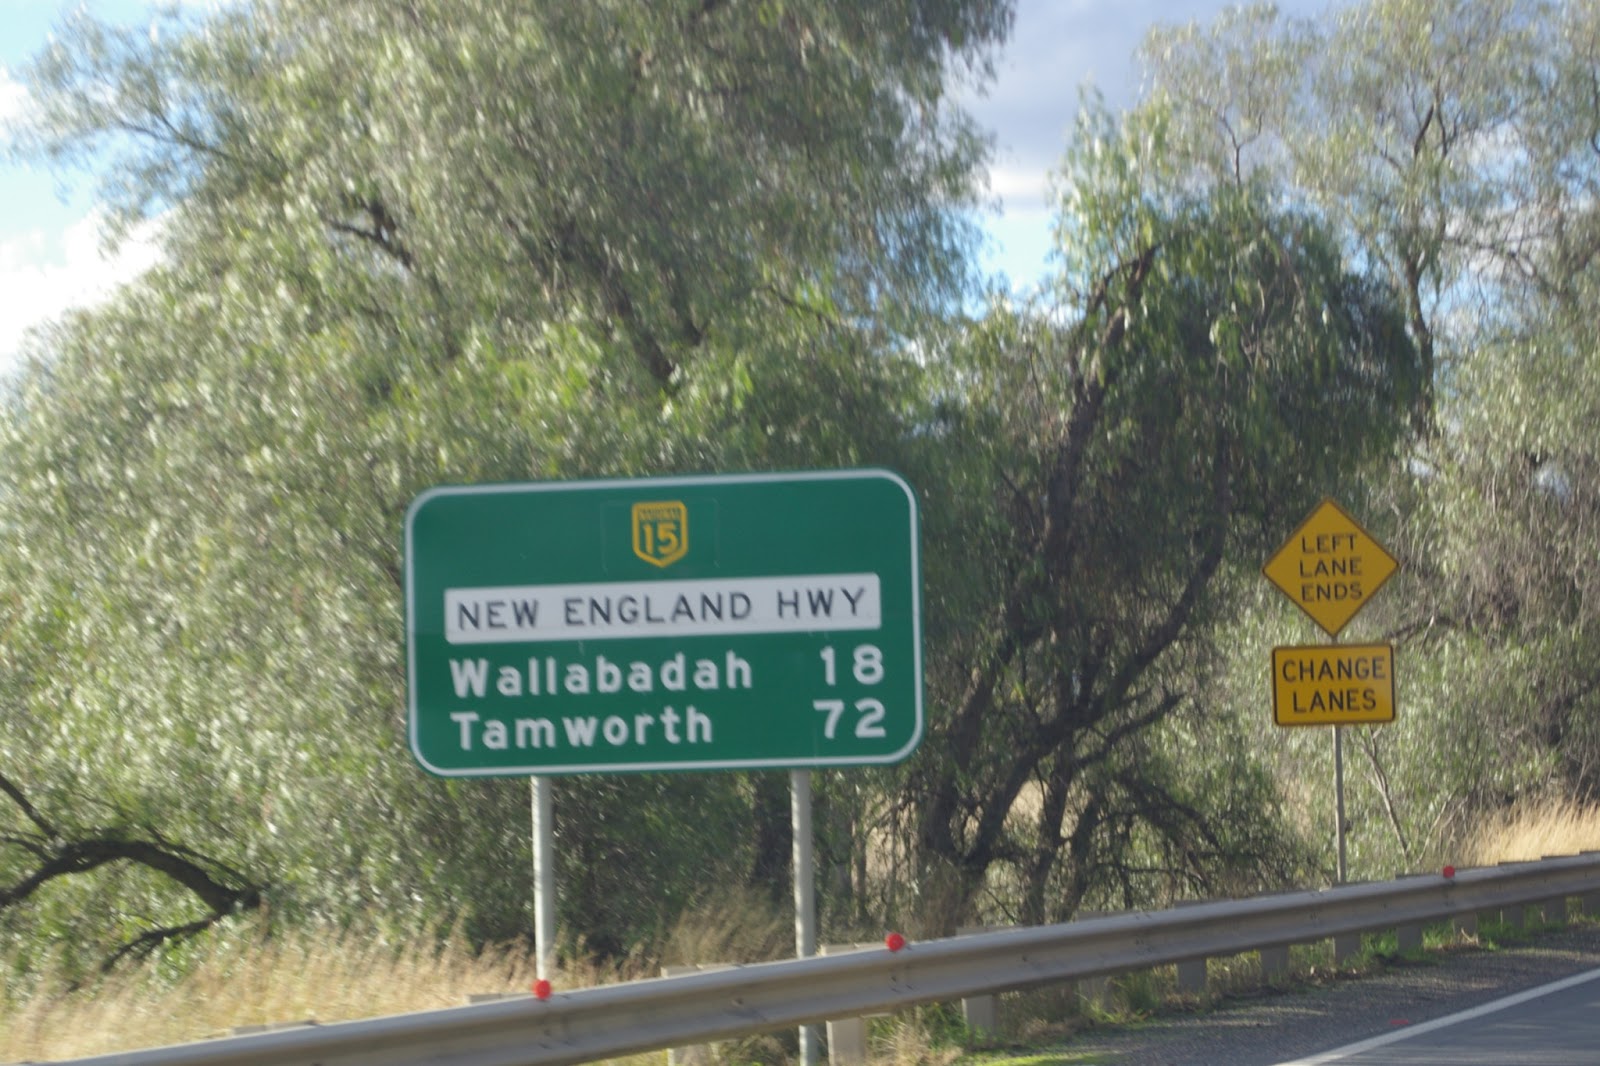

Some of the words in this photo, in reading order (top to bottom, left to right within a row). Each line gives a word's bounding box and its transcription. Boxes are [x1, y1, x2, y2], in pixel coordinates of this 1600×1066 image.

[643, 523, 678, 554] 15
[1302, 533, 1357, 554] LEFT
[1300, 557, 1363, 578] LANE
[1301, 581, 1363, 603] ENDS
[457, 600, 539, 631] NEW
[564, 591, 752, 626] ENGLAND
[777, 586, 866, 619] HWY
[449, 650, 753, 699] Wallabadah
[820, 644, 884, 685] 18
[1282, 656, 1386, 683] CHANGE
[1292, 688, 1376, 714] LANES
[449, 705, 713, 751] Tamworth
[813, 699, 887, 740] 72
